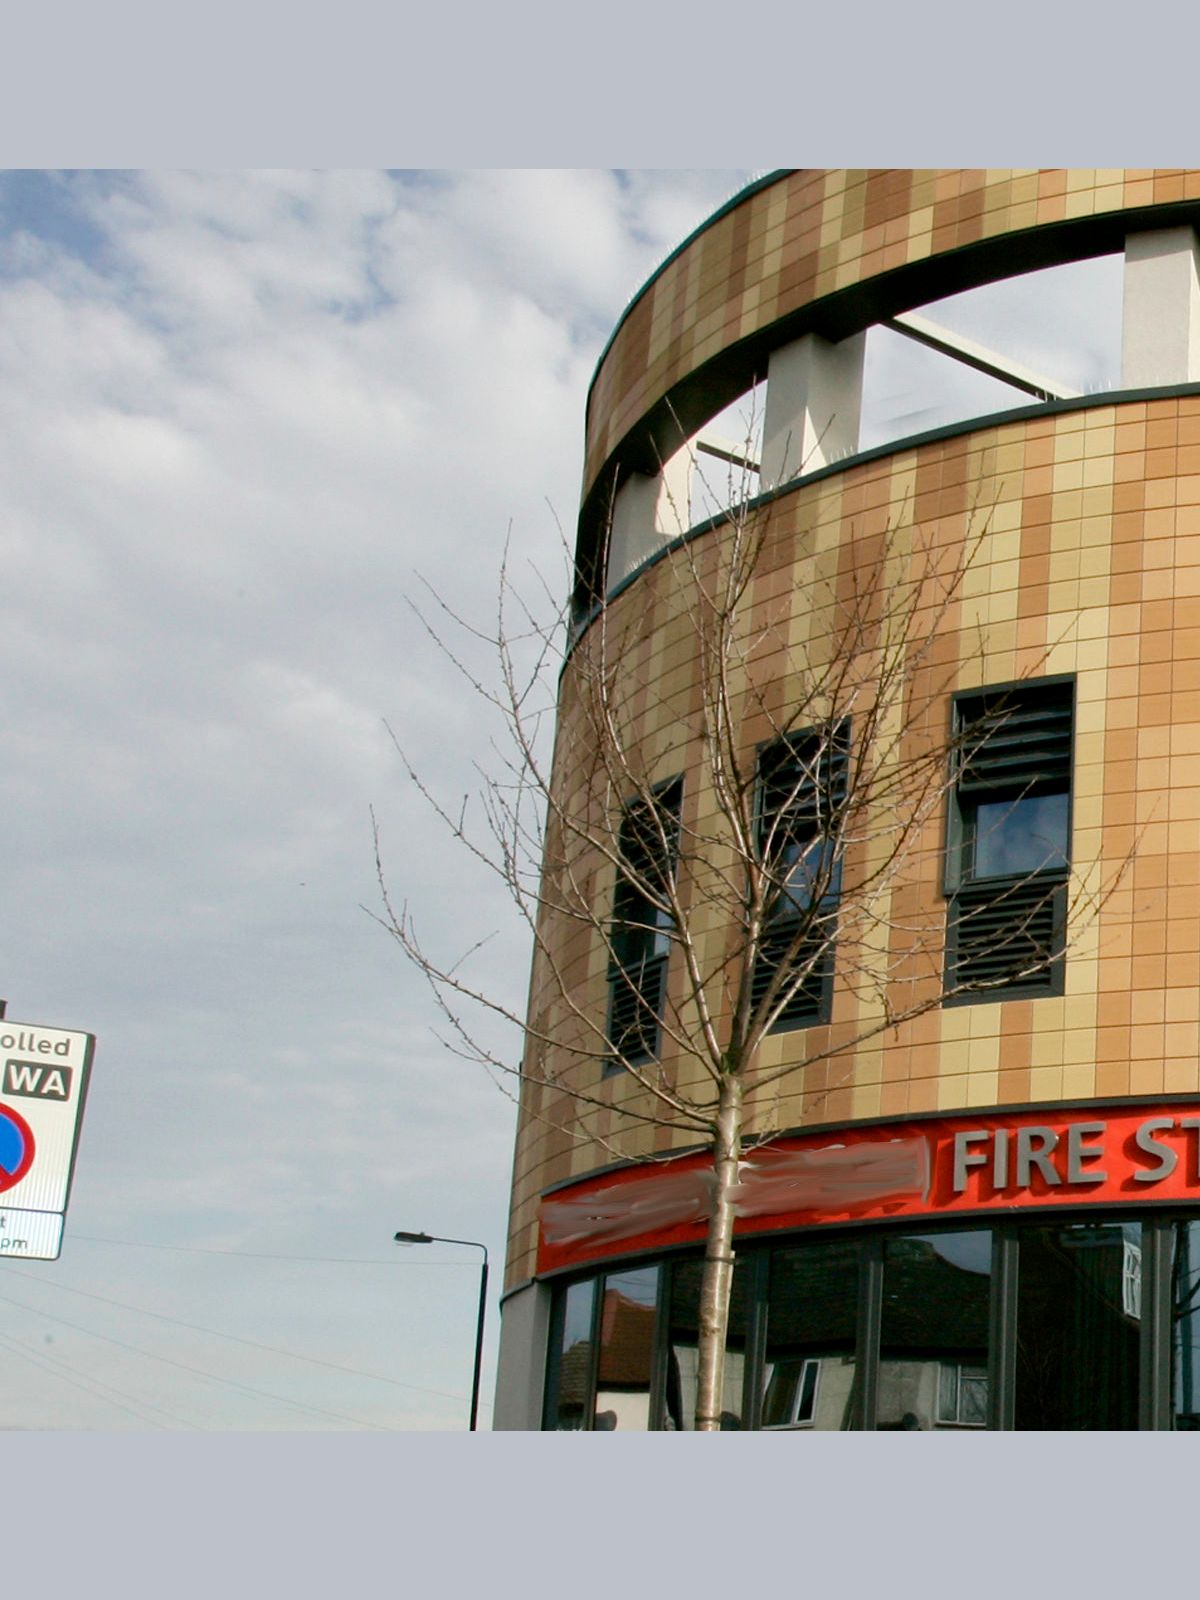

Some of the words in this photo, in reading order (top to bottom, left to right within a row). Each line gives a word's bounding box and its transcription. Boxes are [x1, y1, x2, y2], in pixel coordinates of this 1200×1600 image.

[0, 1032, 71, 1056] olled
[10, 1064, 66, 1097] WA
[953, 1121, 1108, 1192] FIRE
